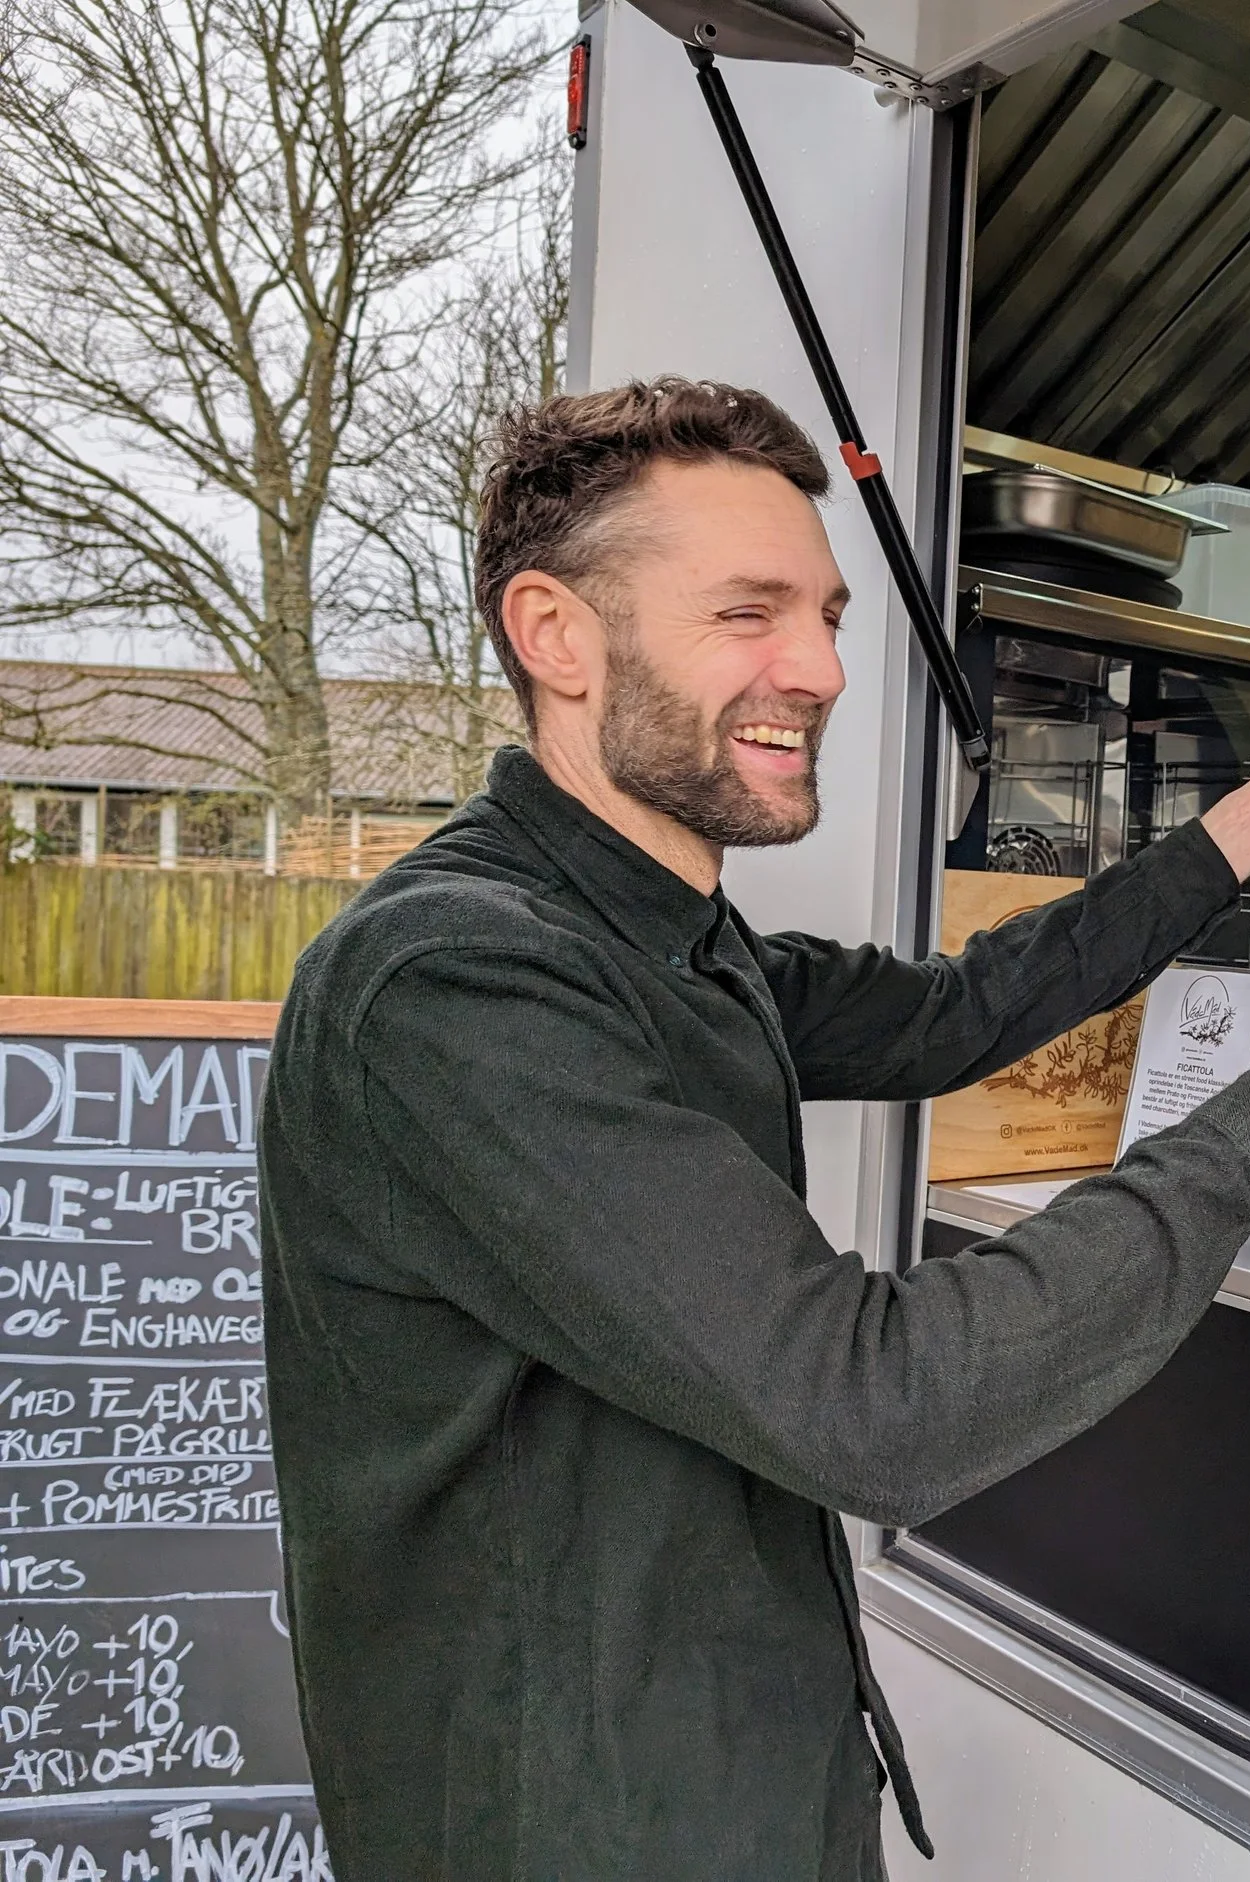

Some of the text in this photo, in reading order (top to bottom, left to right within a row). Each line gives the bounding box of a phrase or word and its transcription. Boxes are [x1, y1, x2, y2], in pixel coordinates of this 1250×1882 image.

[1147, 1068, 1168, 1078] Ficattola
[1181, 1074, 1196, 1083] street
[1196, 1076, 1208, 1085] food
[1177, 1063, 1214, 1077] FICATTOLA
[1148, 1079, 1174, 1089] oprindelse
[1184, 1083, 1210, 1094] Toscanske
[1149, 1087, 1167, 1095] mellem
[1166, 1088, 1180, 1098] Prato
[1180, 1092, 1187, 1100] og
[1141, 1103, 1152, 1111] med
[1023, 1143, 1089, 1157] www.VadeMad.dk
[182, 1207, 261, 1260] BR
[3, 1308, 70, 1338] OG
